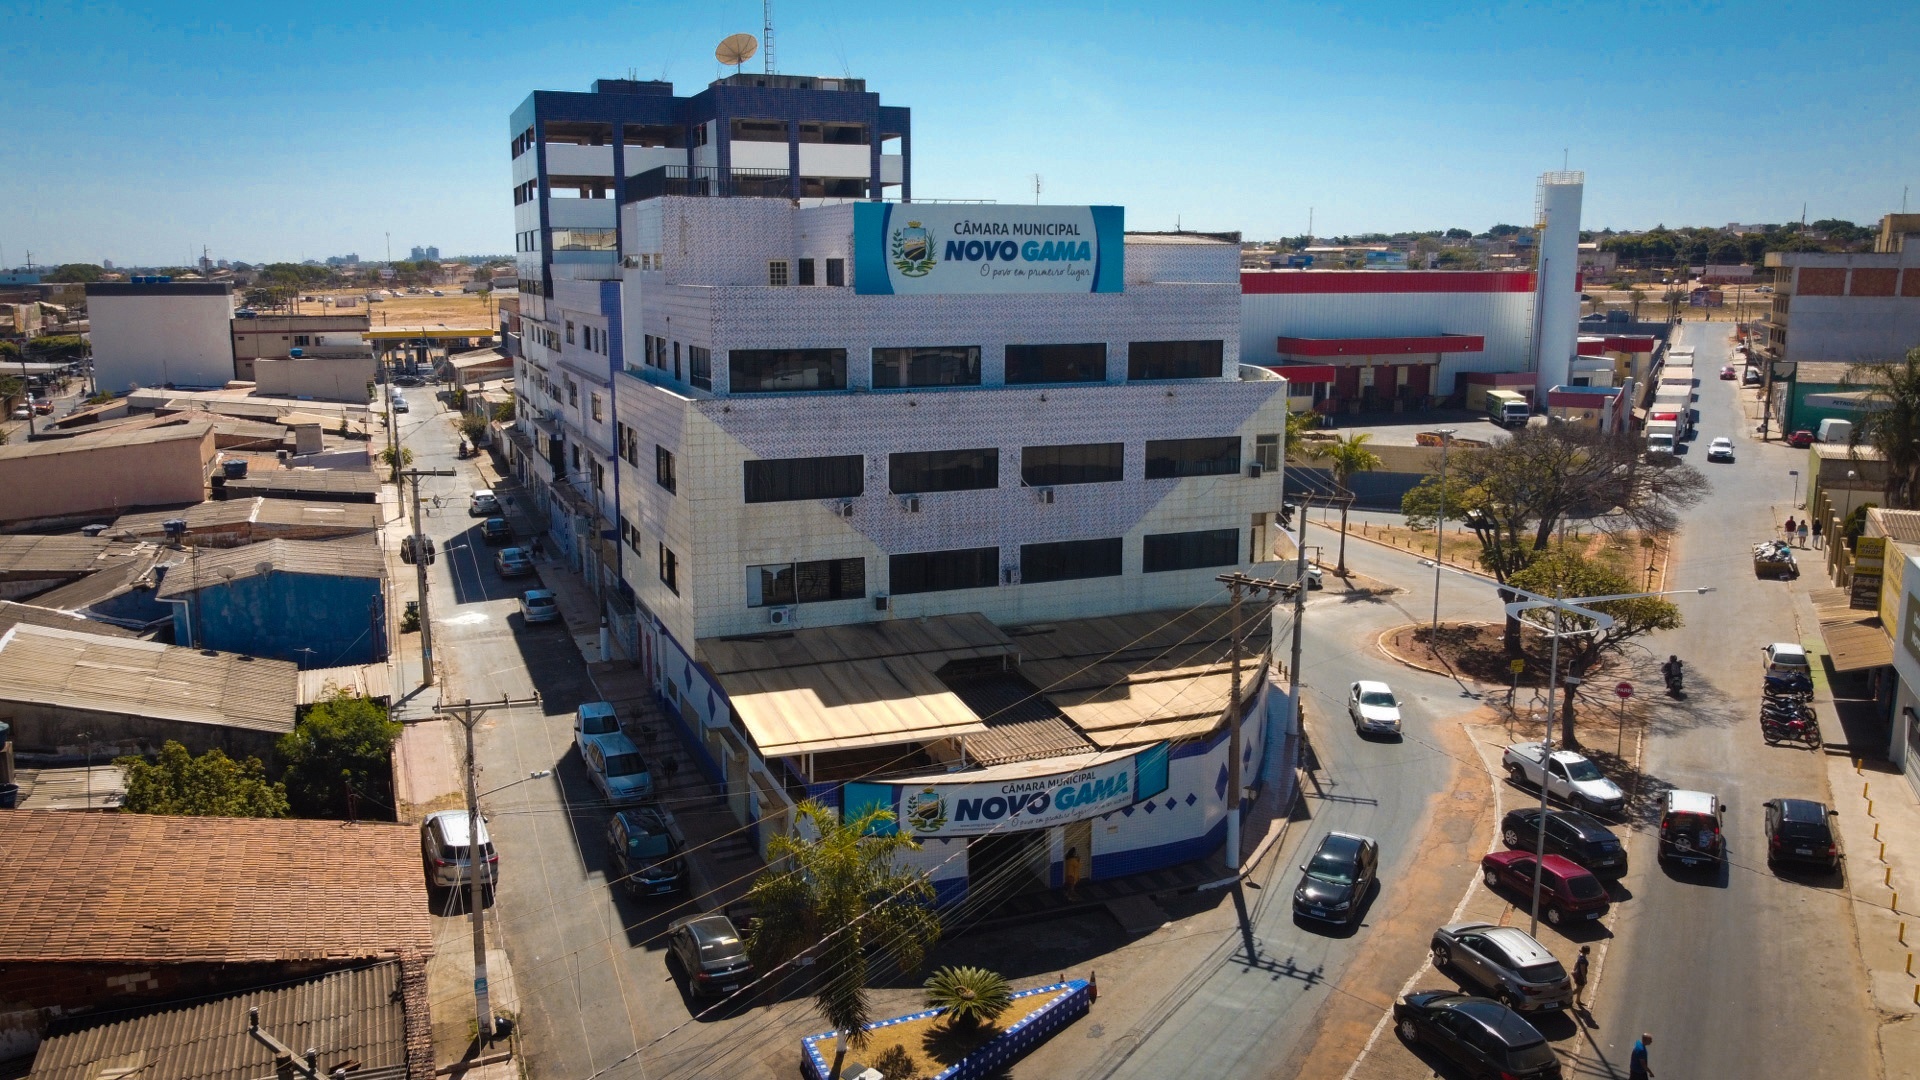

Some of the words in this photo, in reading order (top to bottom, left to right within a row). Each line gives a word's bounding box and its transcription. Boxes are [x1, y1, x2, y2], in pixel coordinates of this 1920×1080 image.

[953, 220, 1010, 236] CÂMARA
[1013, 223, 1081, 236] MUNICIPAL
[944, 240, 1019, 262] NOVO
[1021, 240, 1091, 262] GAMA
[980, 263, 991, 277] O
[992, 267, 1012, 280] povo
[1013, 268, 1026, 276] em
[1028, 267, 1066, 280] primeiro
[1066, 264, 1091, 282] lugar
[1001, 781, 1046, 795] CÂMARA
[1047, 771, 1097, 789] MUNICIPAL
[954, 791, 1051, 822] NOVO
[1054, 772, 1128, 811] GAMA
